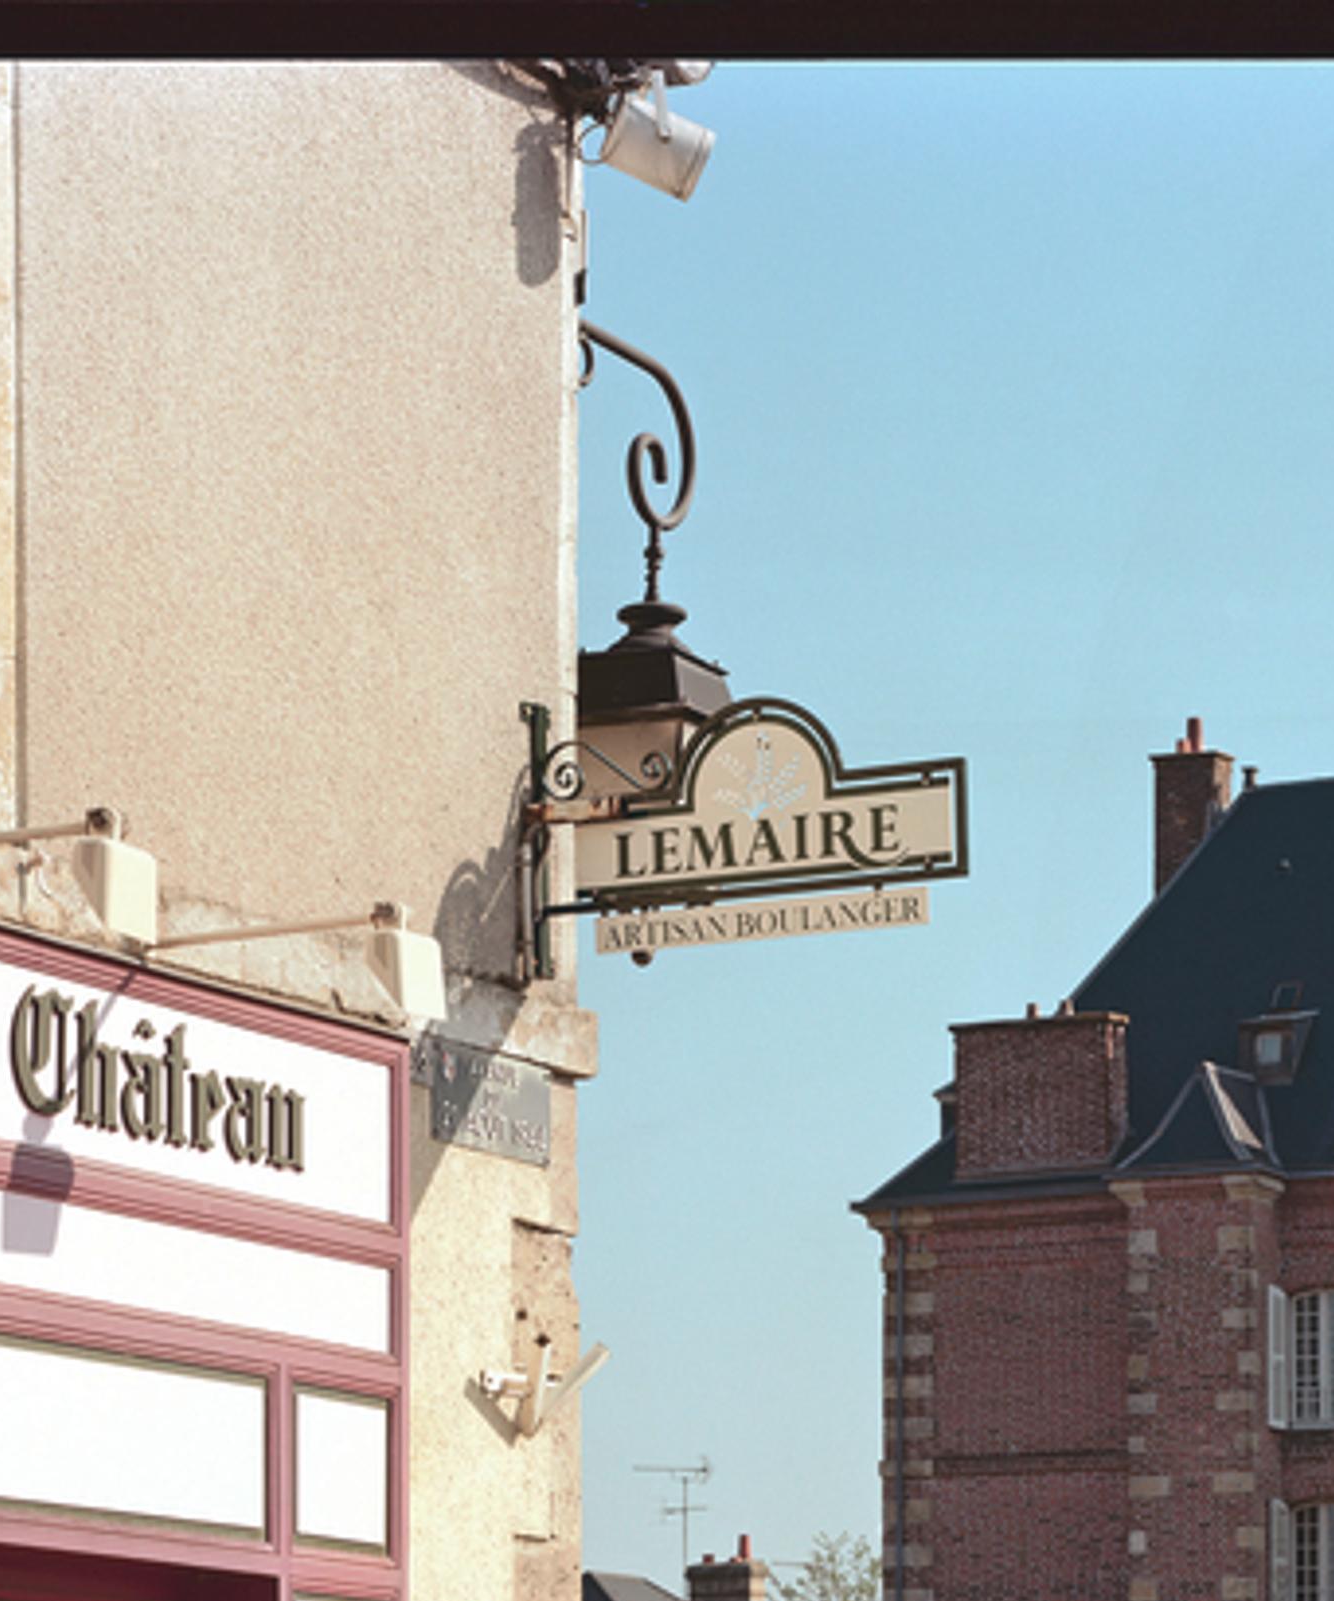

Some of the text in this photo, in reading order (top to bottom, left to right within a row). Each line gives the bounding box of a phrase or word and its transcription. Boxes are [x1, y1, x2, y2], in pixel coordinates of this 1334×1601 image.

[613, 803, 909, 879] LEMAIRE
[603, 896, 923, 951] ARTISAN BOULANGER
[9, 982, 307, 1174] Château
